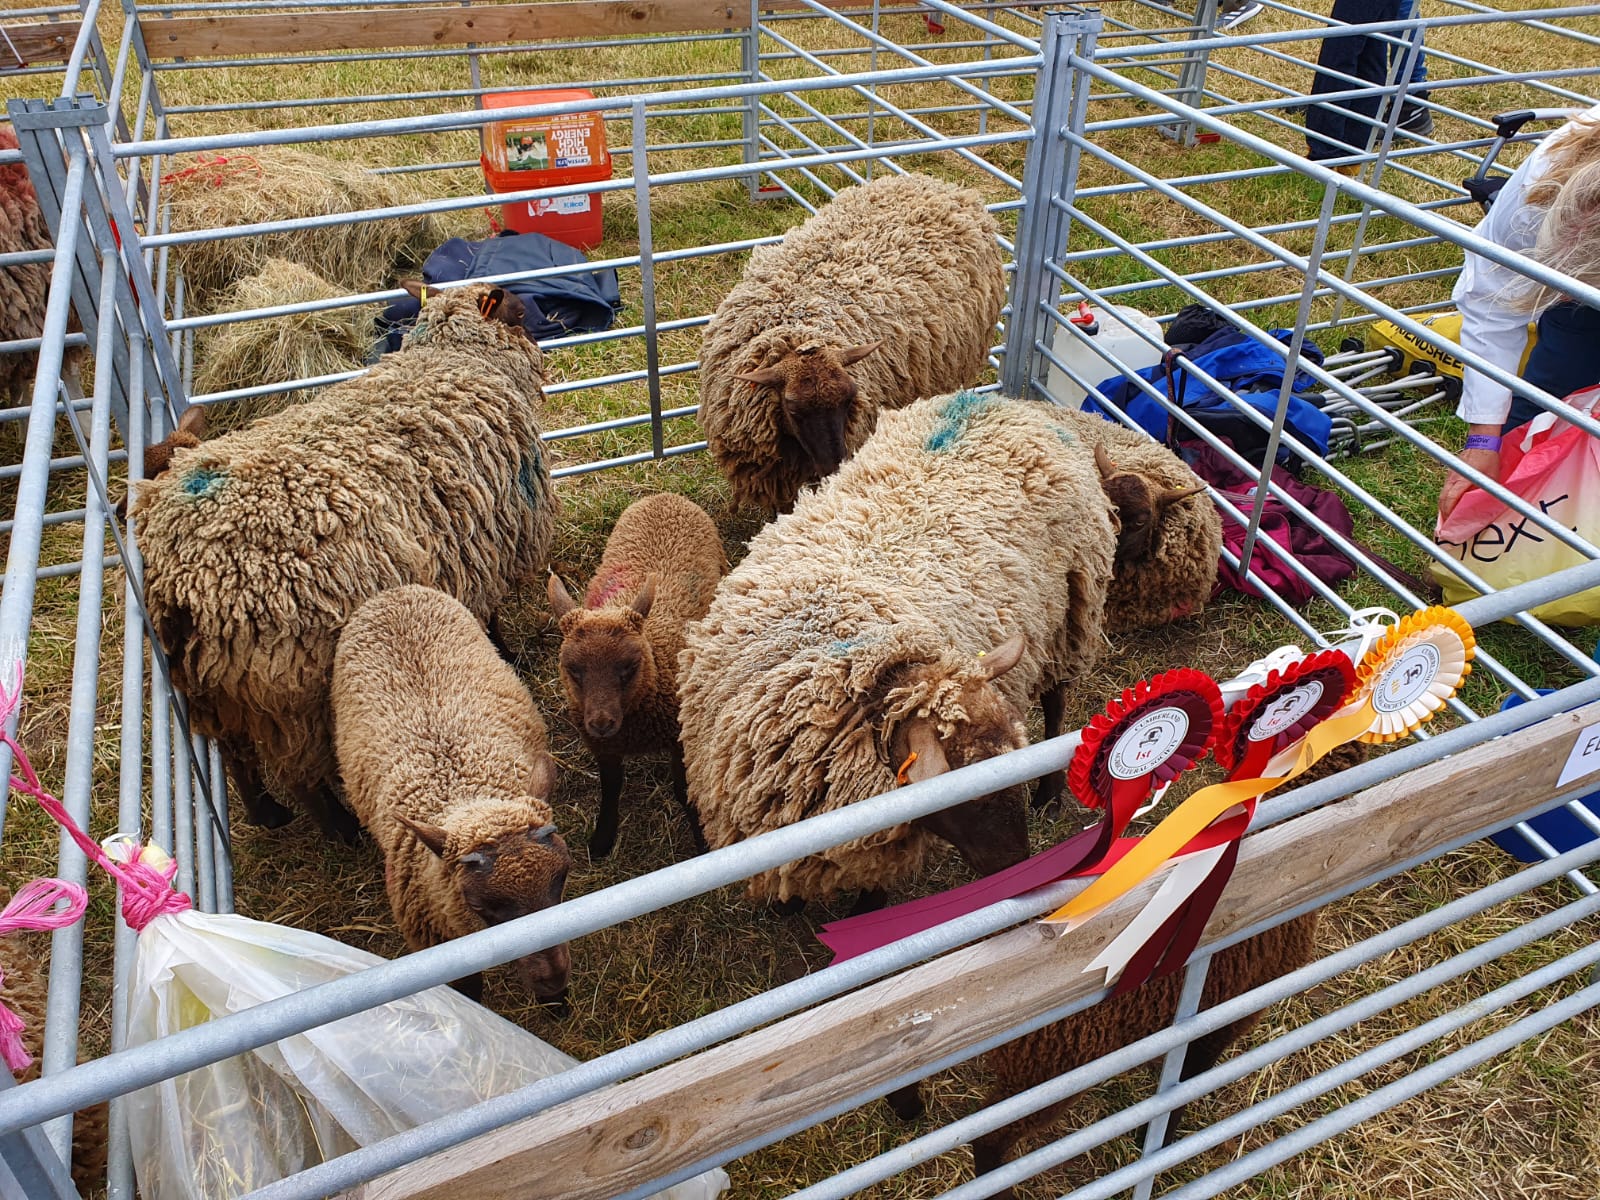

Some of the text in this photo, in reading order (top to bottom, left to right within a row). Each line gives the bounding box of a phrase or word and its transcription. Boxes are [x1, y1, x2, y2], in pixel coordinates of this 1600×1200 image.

[551, 128, 591, 140] ENERGY
[559, 139, 585, 148] HIGH
[556, 146, 588, 157] EXTRA
[1134, 712, 1181, 732] CUMBERLAND
[1114, 739, 1178, 775] AGRICULTURAL SOCIETY
[1136, 750, 1152, 761] 1st
